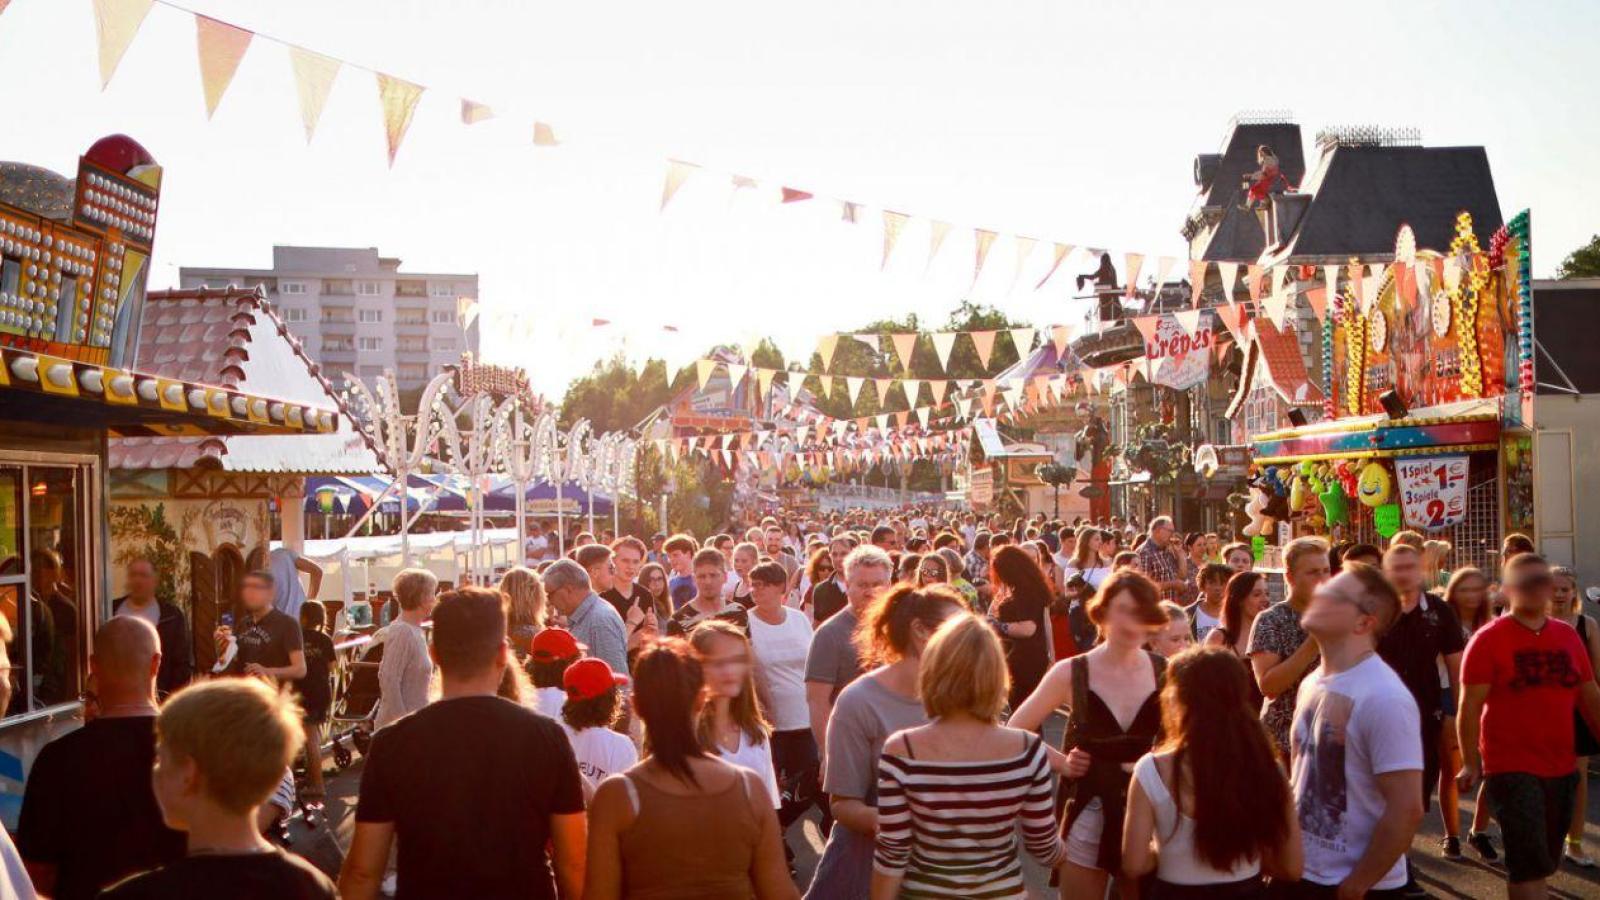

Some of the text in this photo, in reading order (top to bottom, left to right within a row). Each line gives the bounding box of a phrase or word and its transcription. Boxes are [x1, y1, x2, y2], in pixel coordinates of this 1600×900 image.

[1146, 328, 1210, 359] Crêpes
[1400, 465, 1408, 479] 1
[1409, 462, 1432, 479] Spiel
[1405, 489, 1439, 505] 3 Spiele
